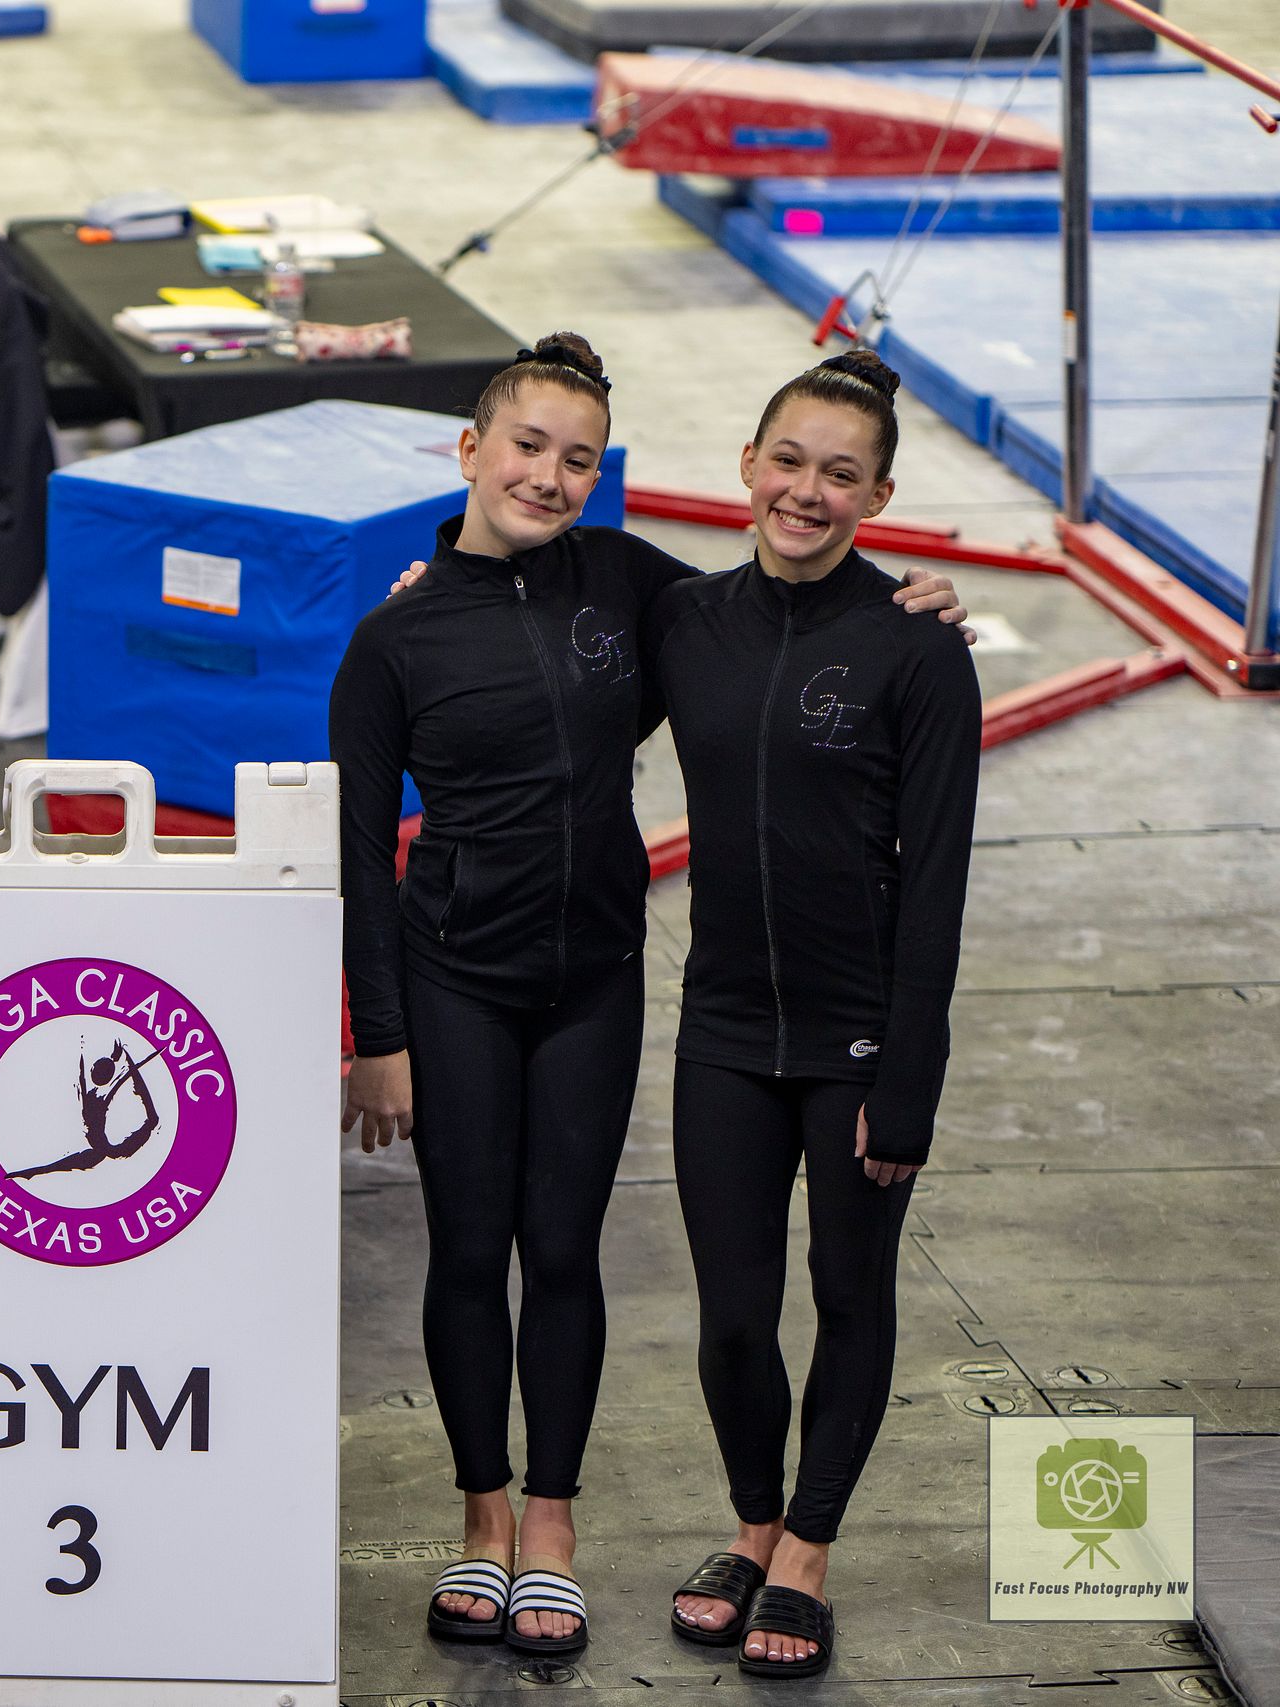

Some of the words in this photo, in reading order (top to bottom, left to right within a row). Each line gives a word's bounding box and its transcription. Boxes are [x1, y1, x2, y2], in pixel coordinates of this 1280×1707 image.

[800, 666, 866, 749] GE
[75, 968, 225, 1102] CLASSIC
[118, 1180, 203, 1244] USA
[44, 1504, 102, 1596] 3
[340, 1546, 465, 1561] NIDEC
[360, 1539, 465, 1547] naturecorp.com
